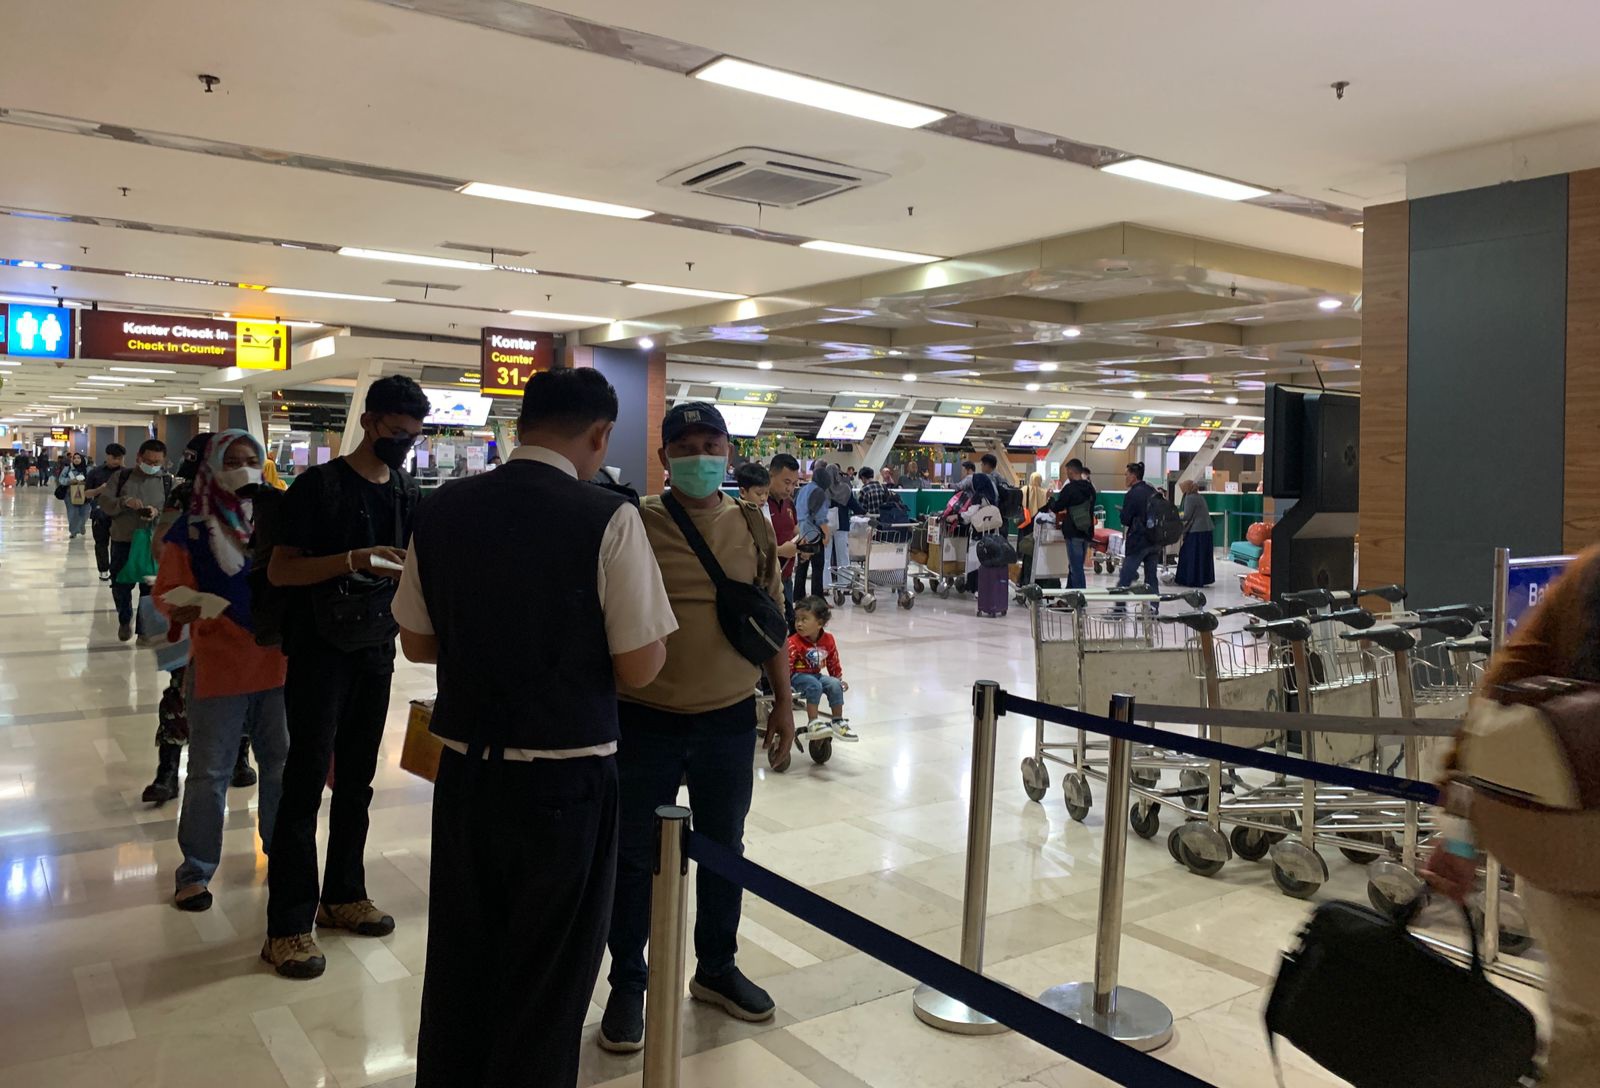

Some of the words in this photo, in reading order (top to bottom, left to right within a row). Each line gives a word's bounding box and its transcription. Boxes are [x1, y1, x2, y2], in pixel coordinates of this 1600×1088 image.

[123, 322, 170, 336] Konter
[172, 325, 213, 339] Check
[216, 328, 229, 340] In
[128, 340, 165, 351] Check
[167, 342, 178, 352] In
[181, 343, 226, 355] Counter
[491, 335, 537, 350] Konter
[491, 352, 534, 364] Counter
[872, 400, 884, 409] 34
